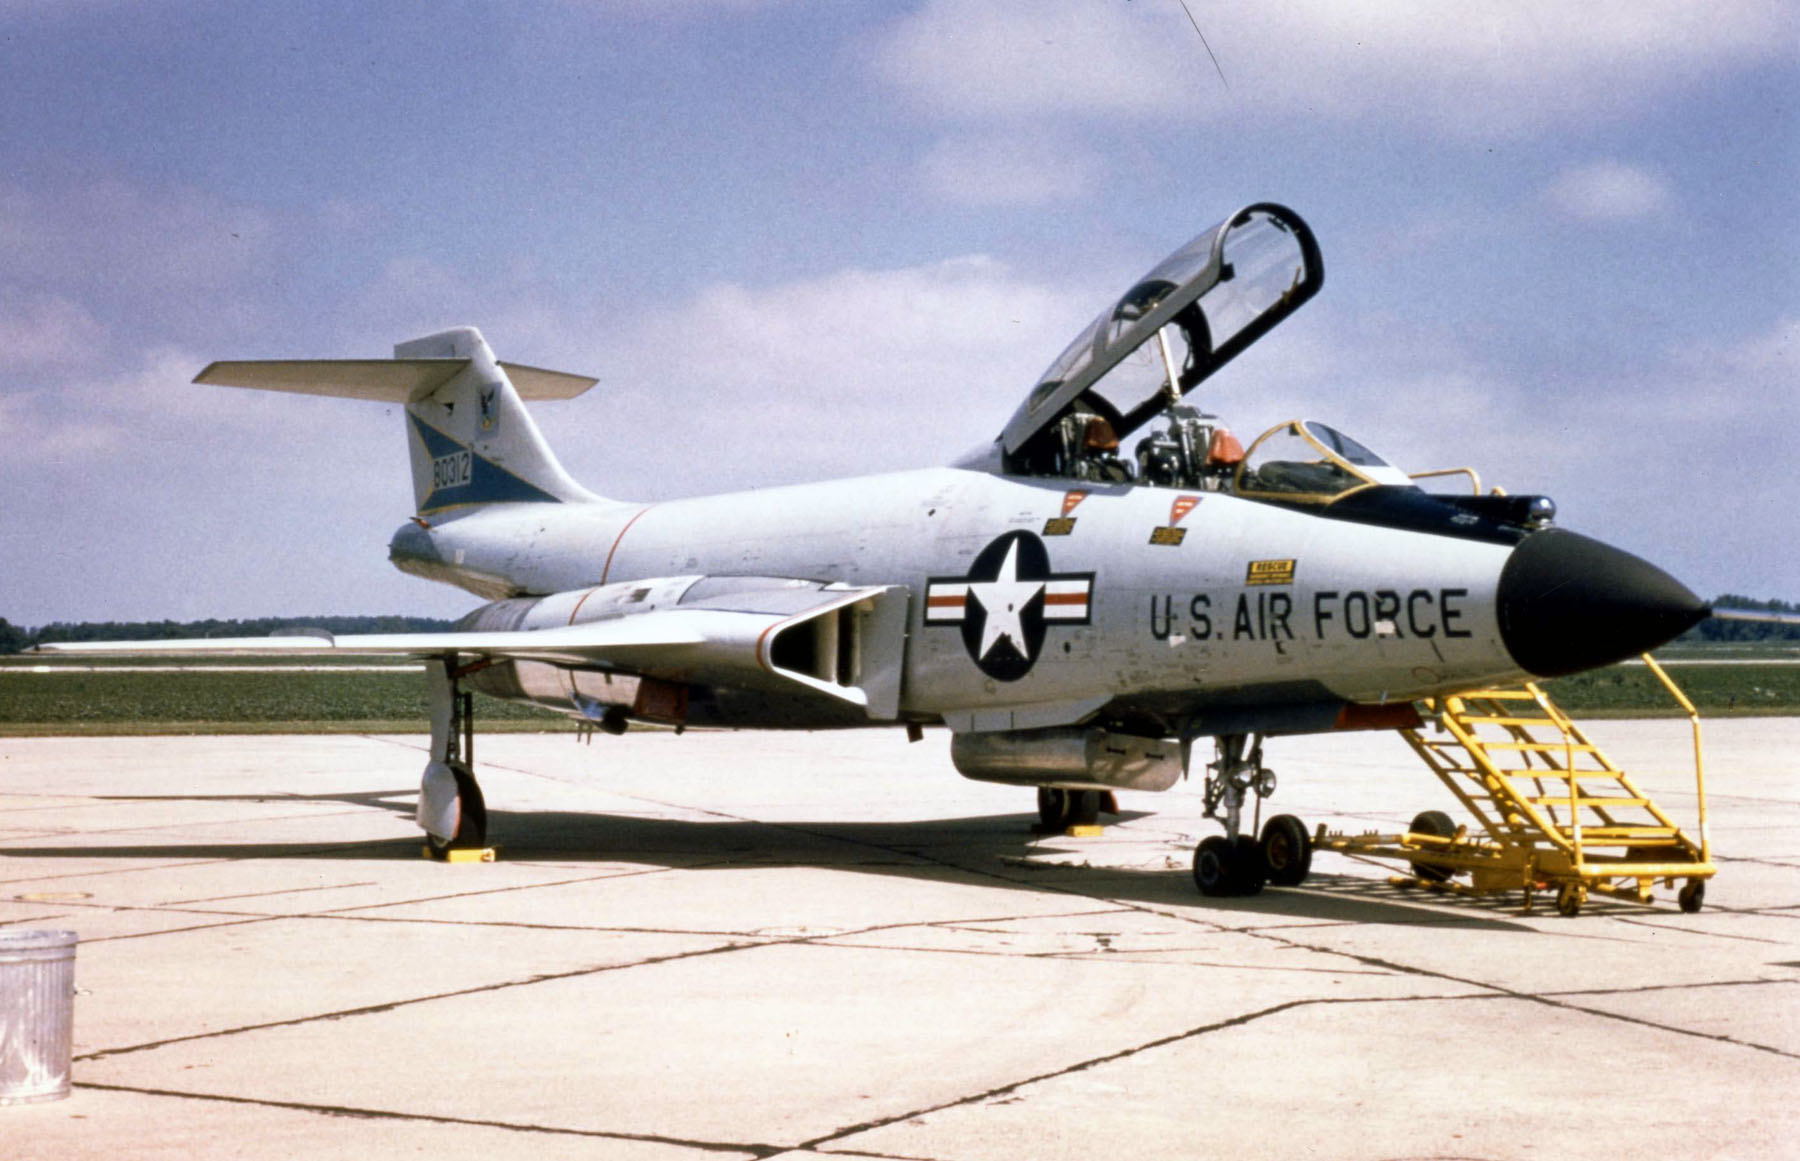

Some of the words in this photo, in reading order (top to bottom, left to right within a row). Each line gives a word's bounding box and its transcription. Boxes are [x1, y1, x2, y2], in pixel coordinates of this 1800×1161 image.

[434, 452, 469, 488] 80312
[1233, 593, 1294, 640] AIR
[1314, 589, 1472, 638] FORCE
